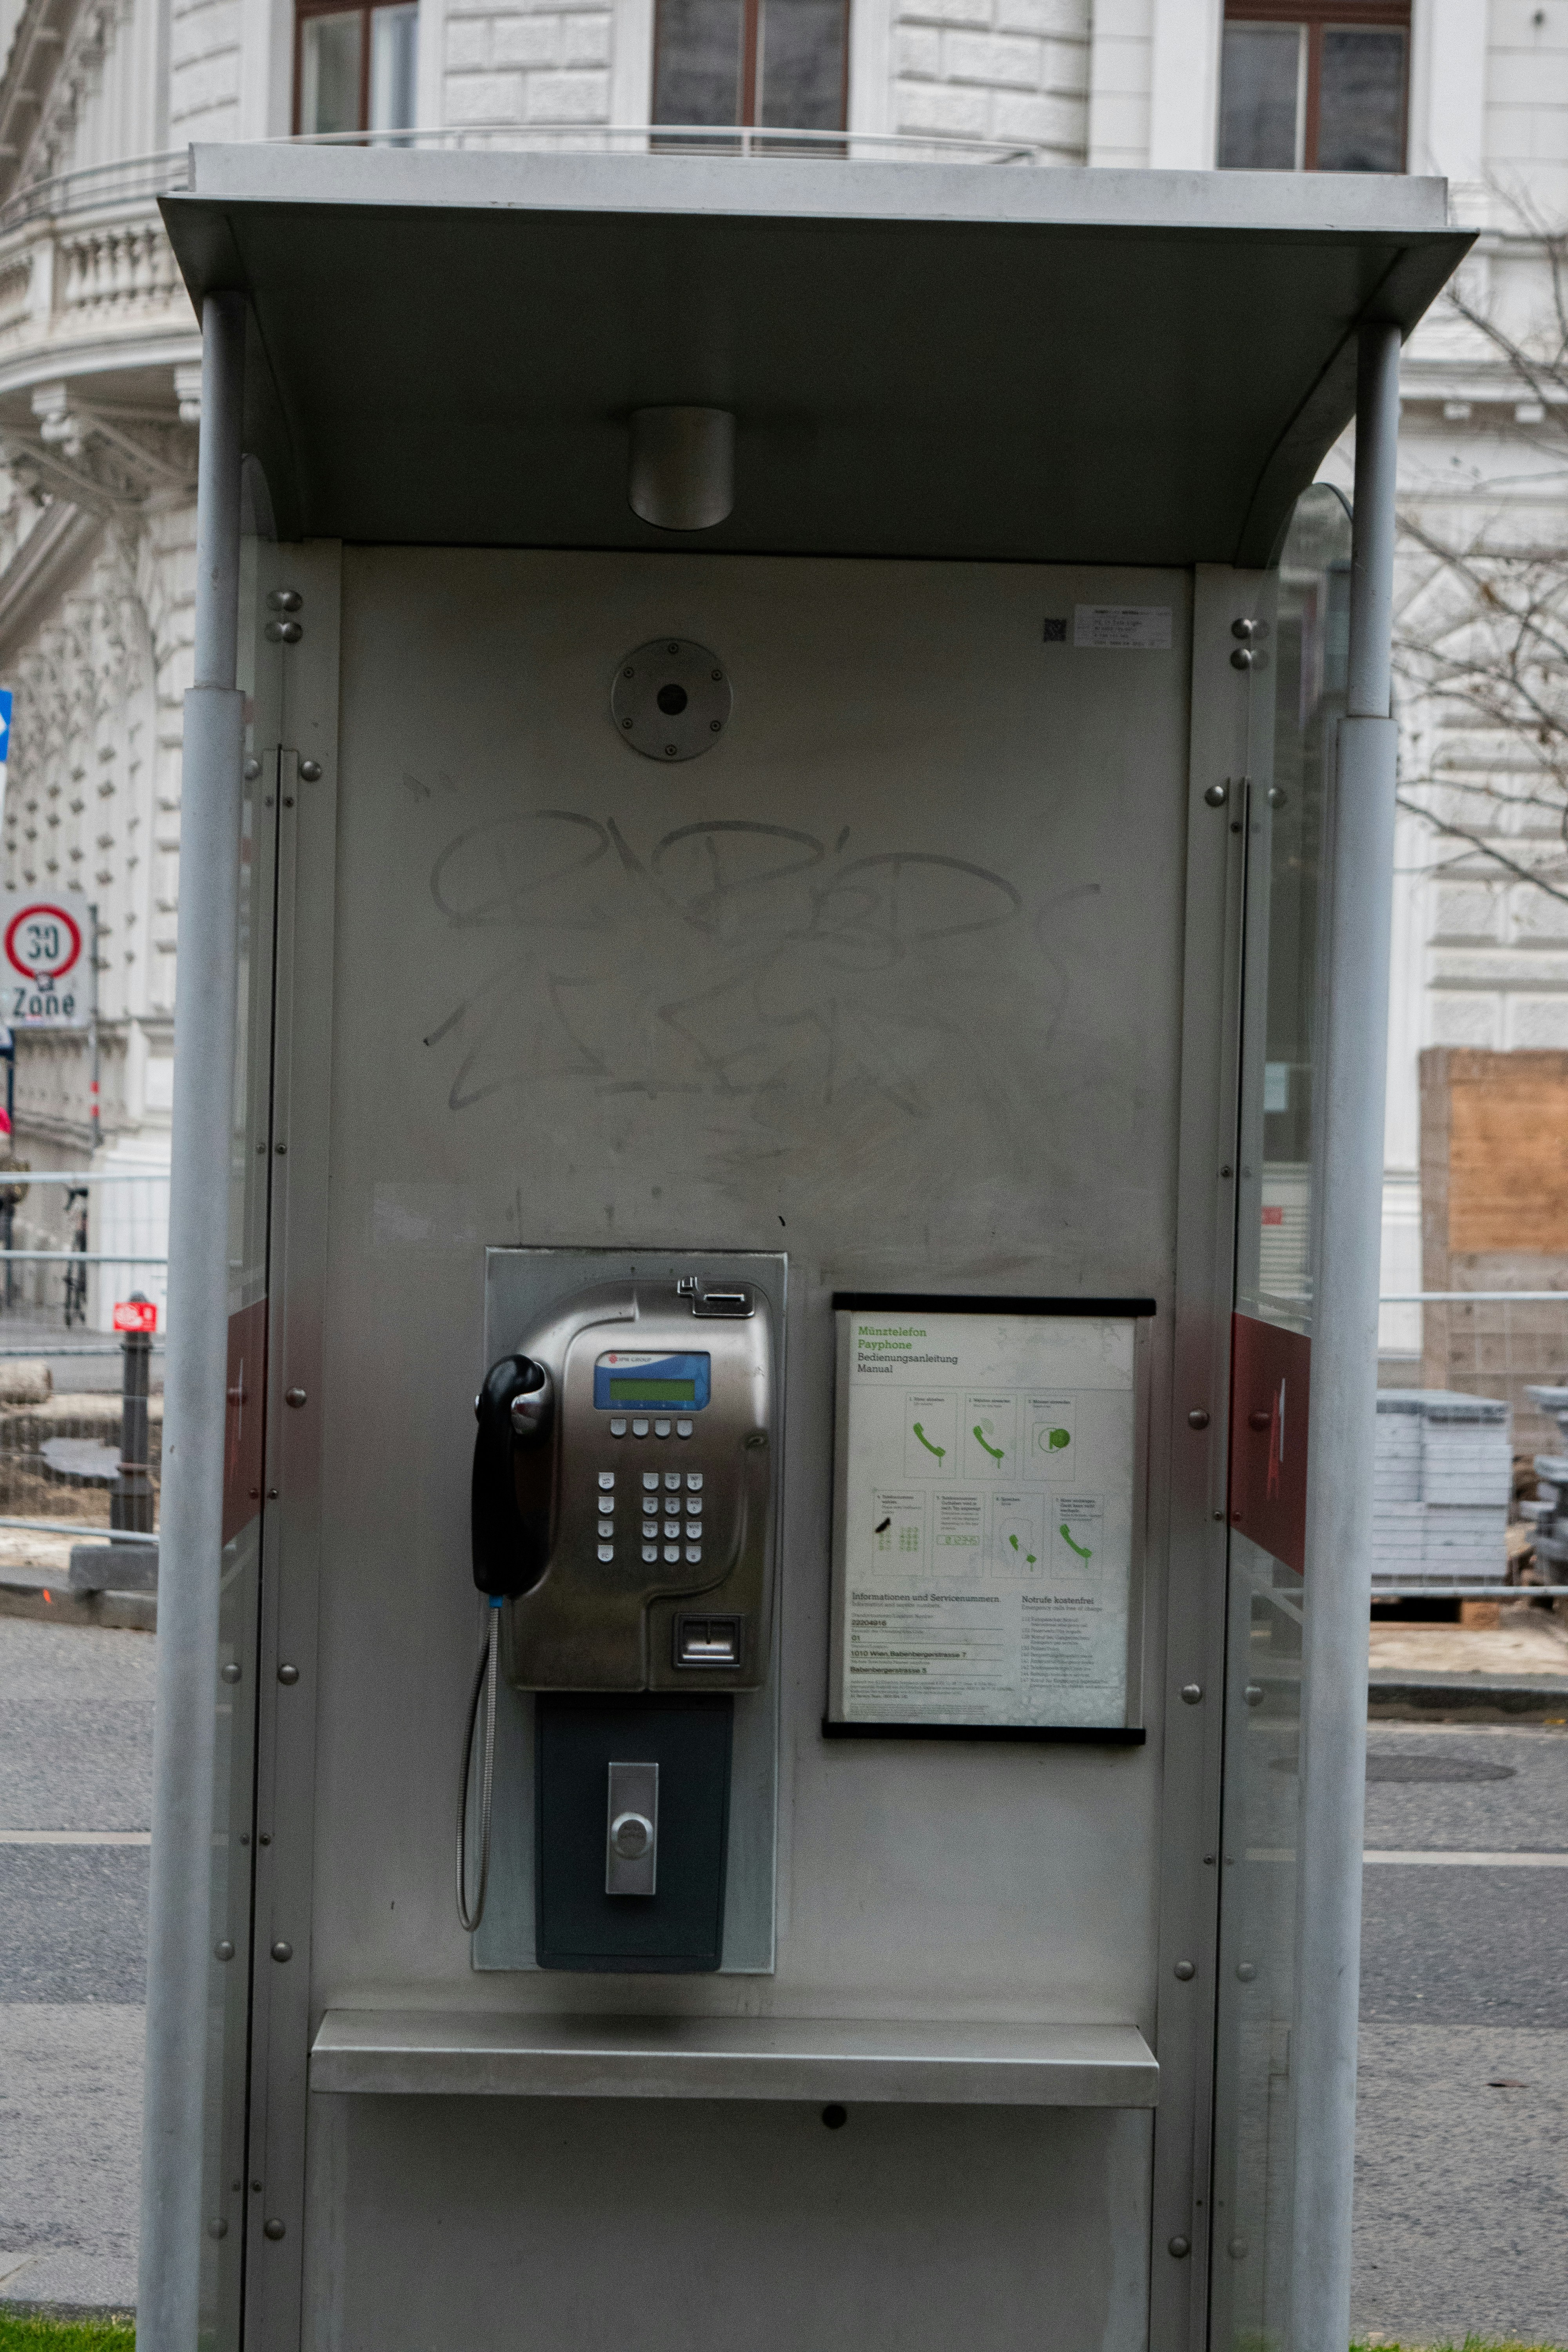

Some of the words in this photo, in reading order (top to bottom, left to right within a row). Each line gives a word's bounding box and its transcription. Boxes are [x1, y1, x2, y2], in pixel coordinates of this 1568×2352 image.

[27, 923, 60, 960] 30
[13, 986, 76, 1018] Zone
[858, 1325, 927, 1337] Münztelefon
[858, 1339, 913, 1350] Payphone
[857, 1352, 958, 1365] Bedienungsanleitung
[857, 1364, 893, 1373] Manual
[852, 1592, 911, 1601] Informationen
[1054, 1596, 1094, 1604] kostenfrei
